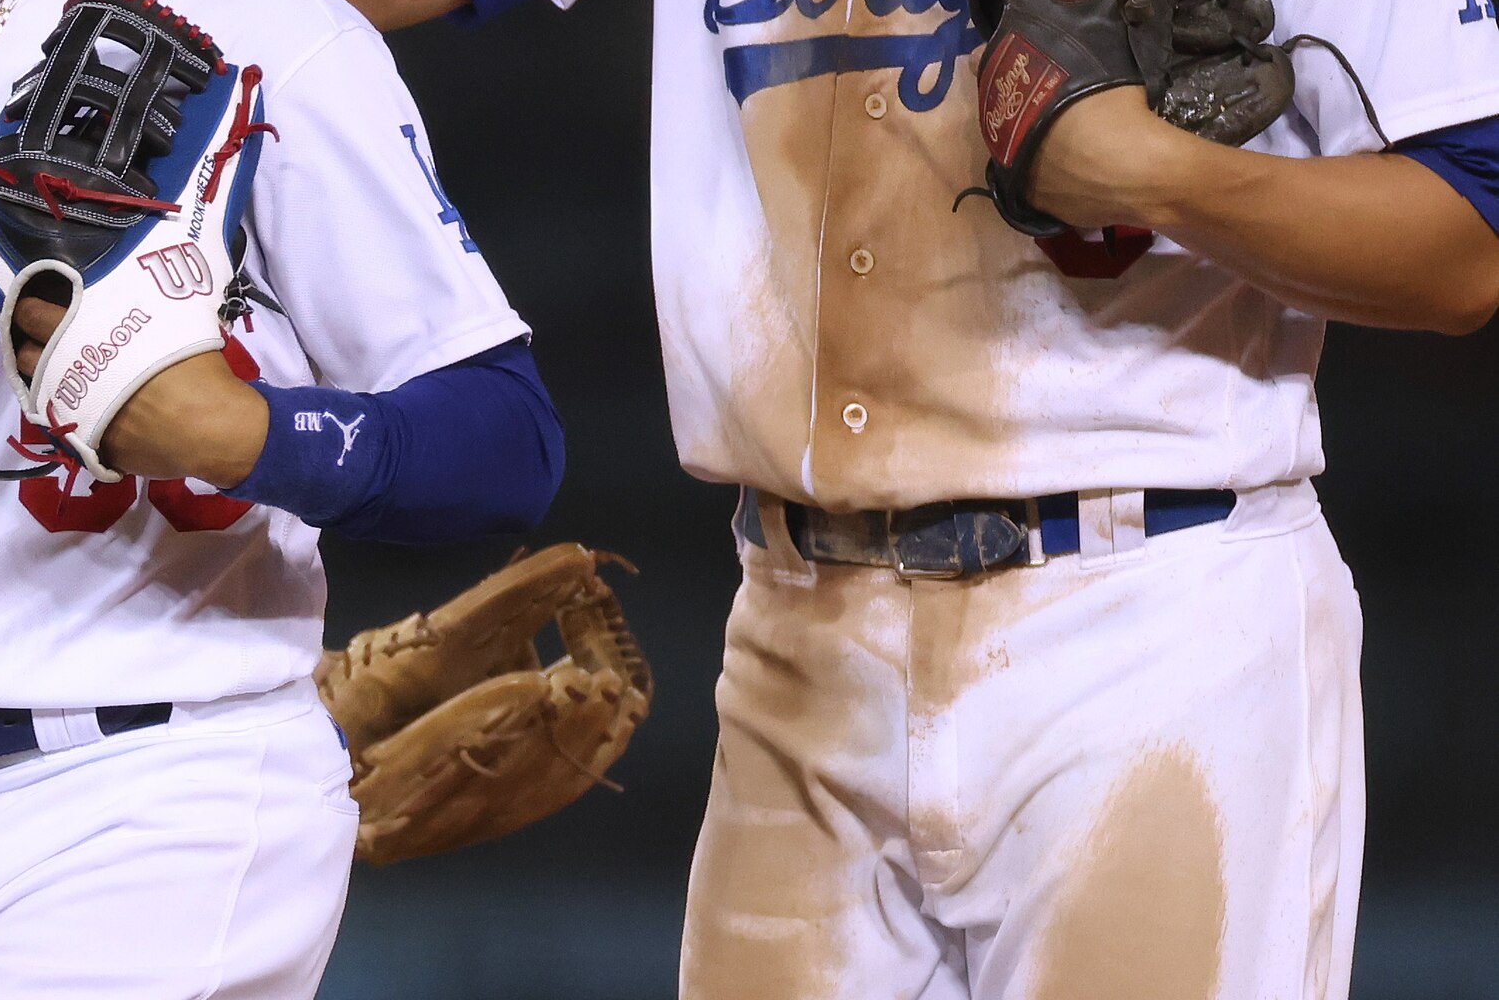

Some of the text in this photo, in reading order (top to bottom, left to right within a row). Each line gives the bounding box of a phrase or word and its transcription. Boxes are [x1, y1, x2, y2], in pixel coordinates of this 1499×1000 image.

[985, 52, 1031, 142] Rawlings
[136, 241, 214, 300] W
[55, 307, 152, 411] Wilson
